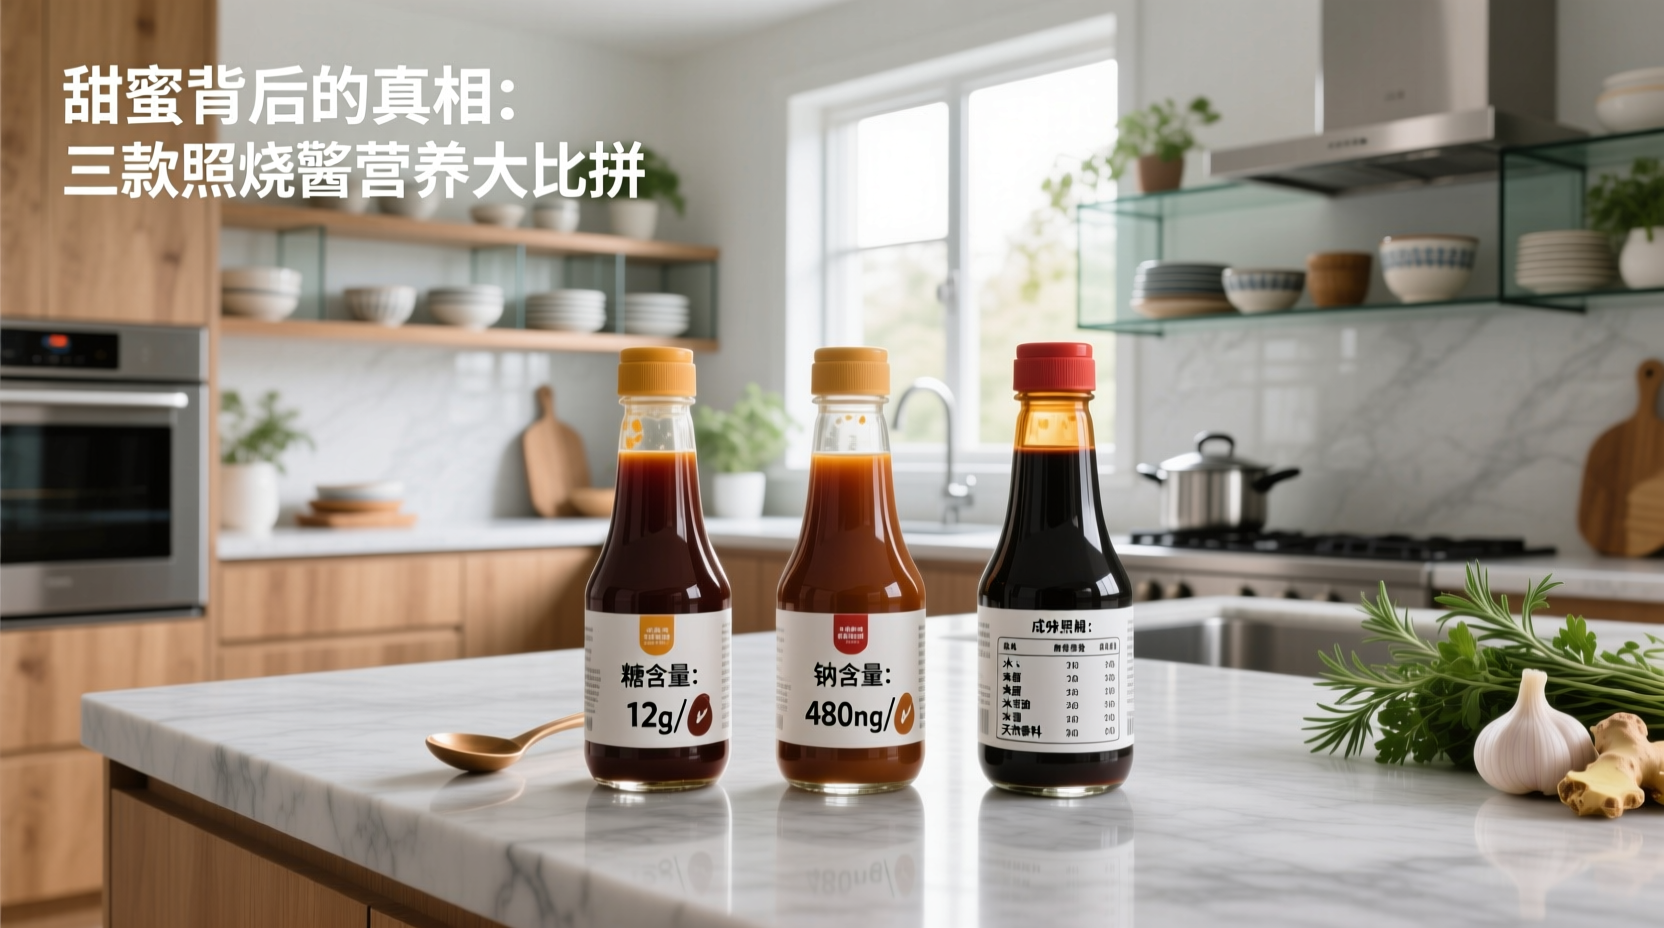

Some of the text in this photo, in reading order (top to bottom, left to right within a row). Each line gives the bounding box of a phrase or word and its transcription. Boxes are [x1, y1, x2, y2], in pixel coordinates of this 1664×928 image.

[620, 662, 698, 689] 糖含量：
[813, 661, 891, 688] 钠含量：
